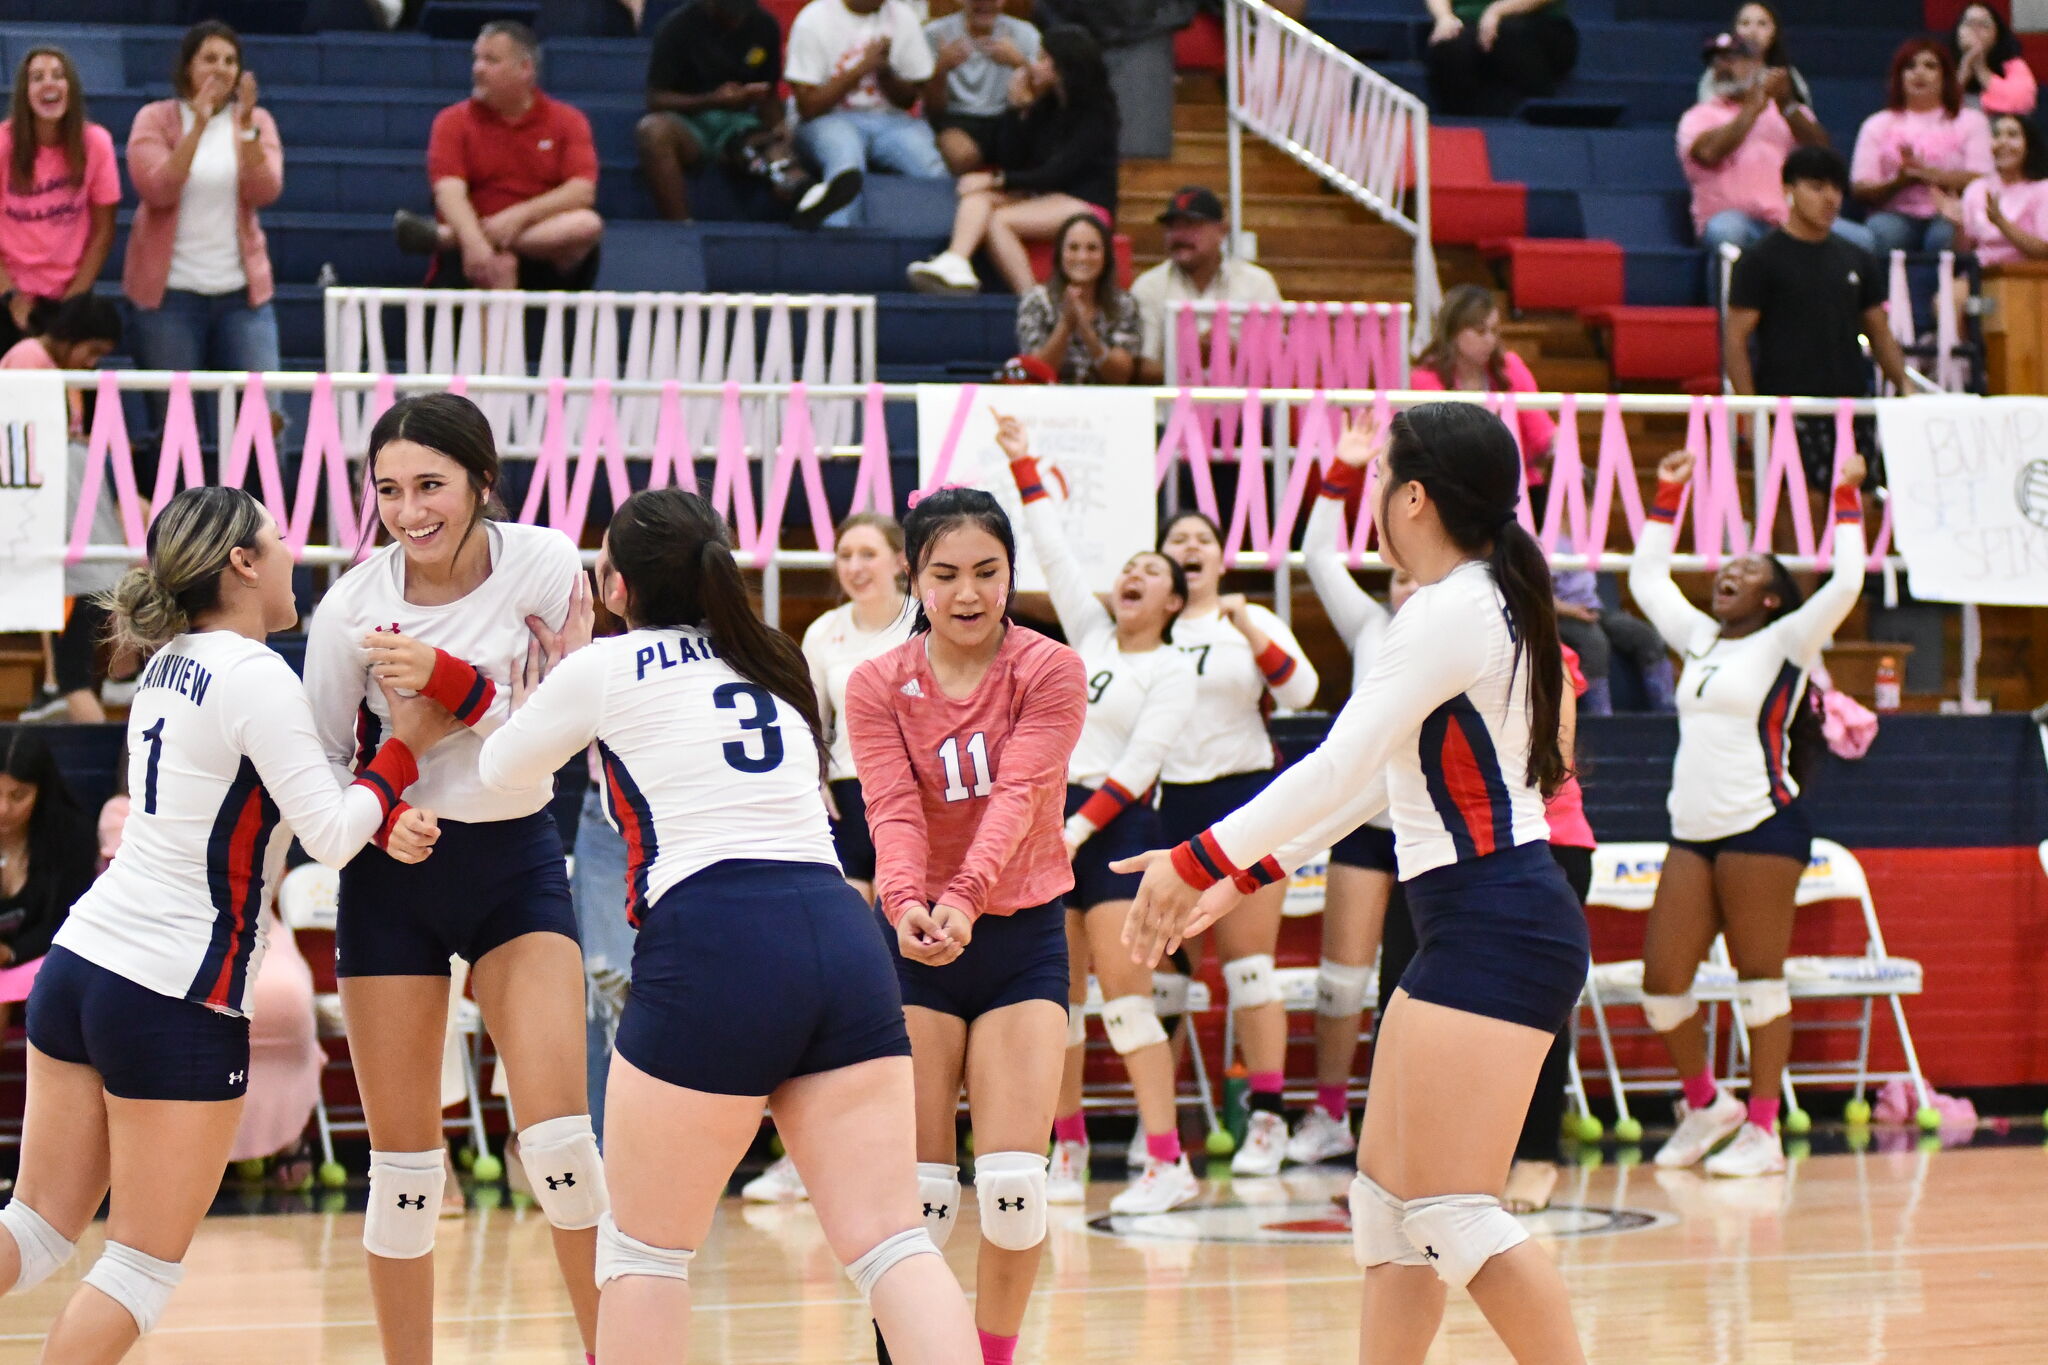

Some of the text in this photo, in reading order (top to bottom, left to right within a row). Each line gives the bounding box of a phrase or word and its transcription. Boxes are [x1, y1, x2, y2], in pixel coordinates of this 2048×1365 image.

[1923, 407, 2043, 477] BUMP
[1695, 664, 1719, 699] 7
[712, 682, 784, 773] 3
[142, 717, 166, 815] 1
[938, 731, 996, 802] 11
